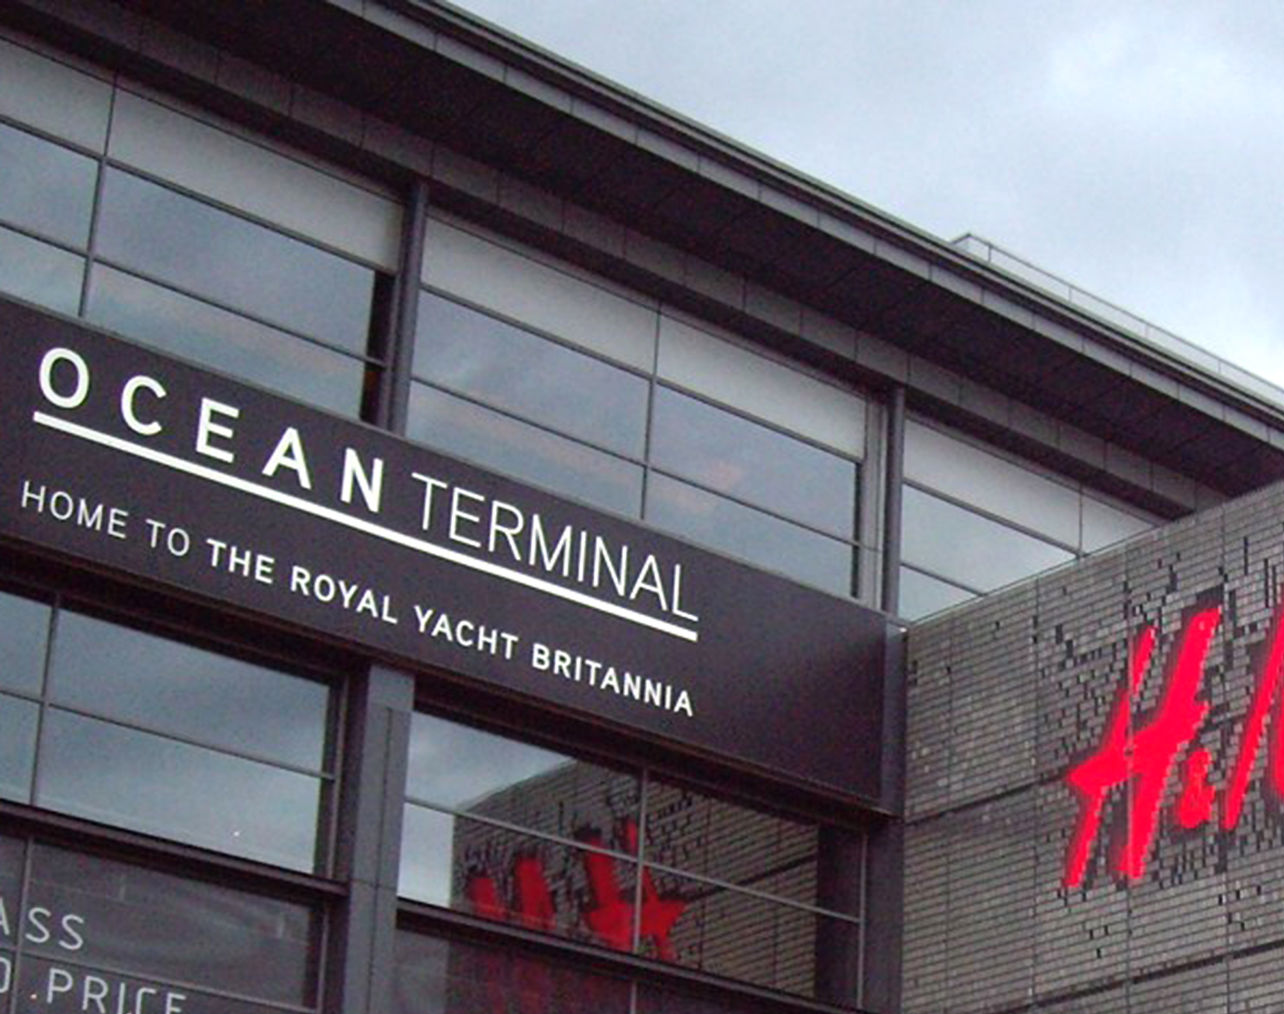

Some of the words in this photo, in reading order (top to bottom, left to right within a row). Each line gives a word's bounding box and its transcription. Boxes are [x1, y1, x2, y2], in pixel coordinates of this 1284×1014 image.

[21, 481, 128, 539] HOME
[146, 519, 190, 557] TO
[207, 538, 275, 584] THE
[291, 565, 398, 624] ROYAL
[414, 606, 519, 661] YACHT
[532, 643, 693, 717] BRITANNIA
[40, 348, 383, 512] OCEAN
[412, 473, 699, 622] TERMINAL
